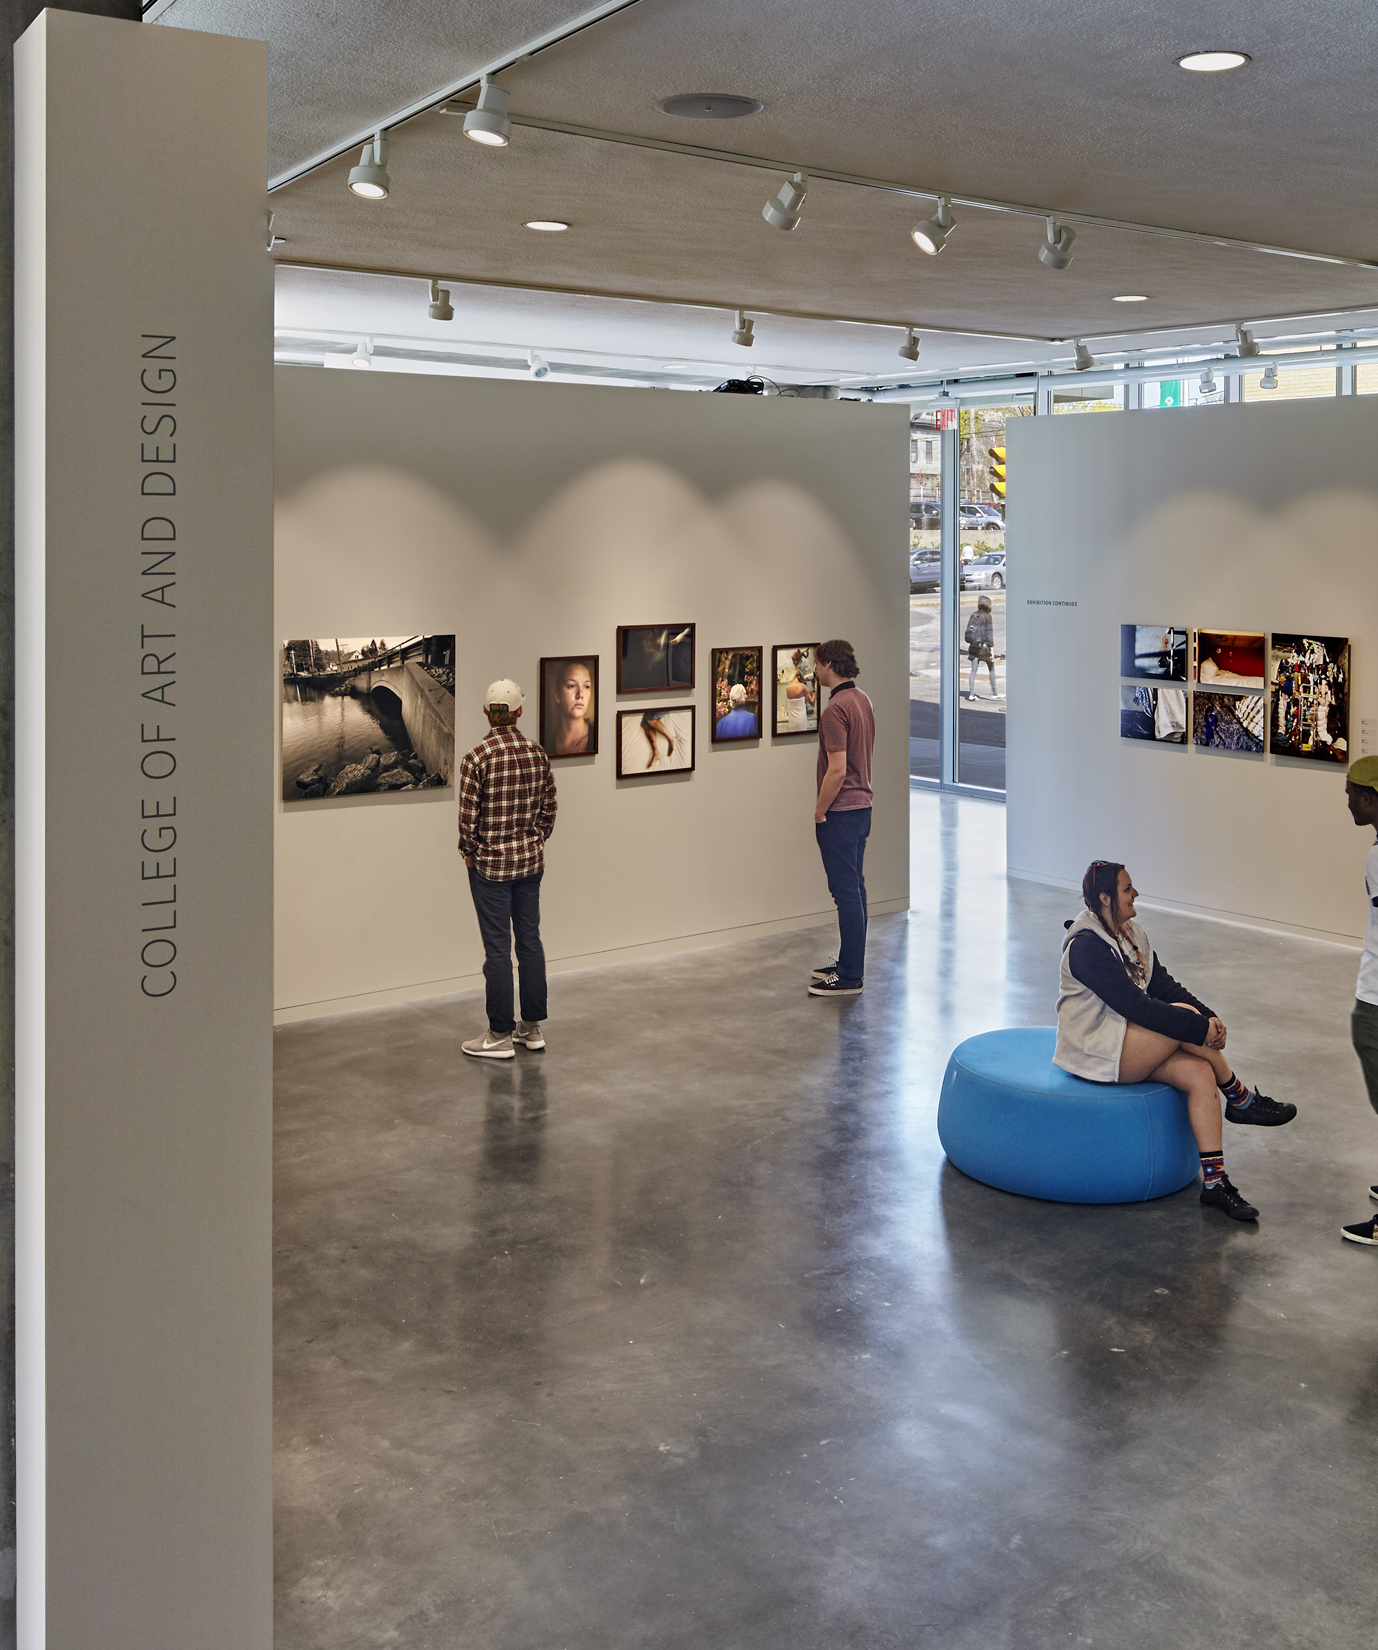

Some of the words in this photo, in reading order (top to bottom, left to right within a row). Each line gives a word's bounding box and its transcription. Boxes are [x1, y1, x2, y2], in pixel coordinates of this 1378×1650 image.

[141, 334, 177, 496] DESIGN
[935, 409, 955, 430] EXIT
[141, 516, 177, 607] AND
[141, 624, 177, 706] ART
[141, 723, 177, 779] OF
[141, 796, 177, 998] COLLEGE
